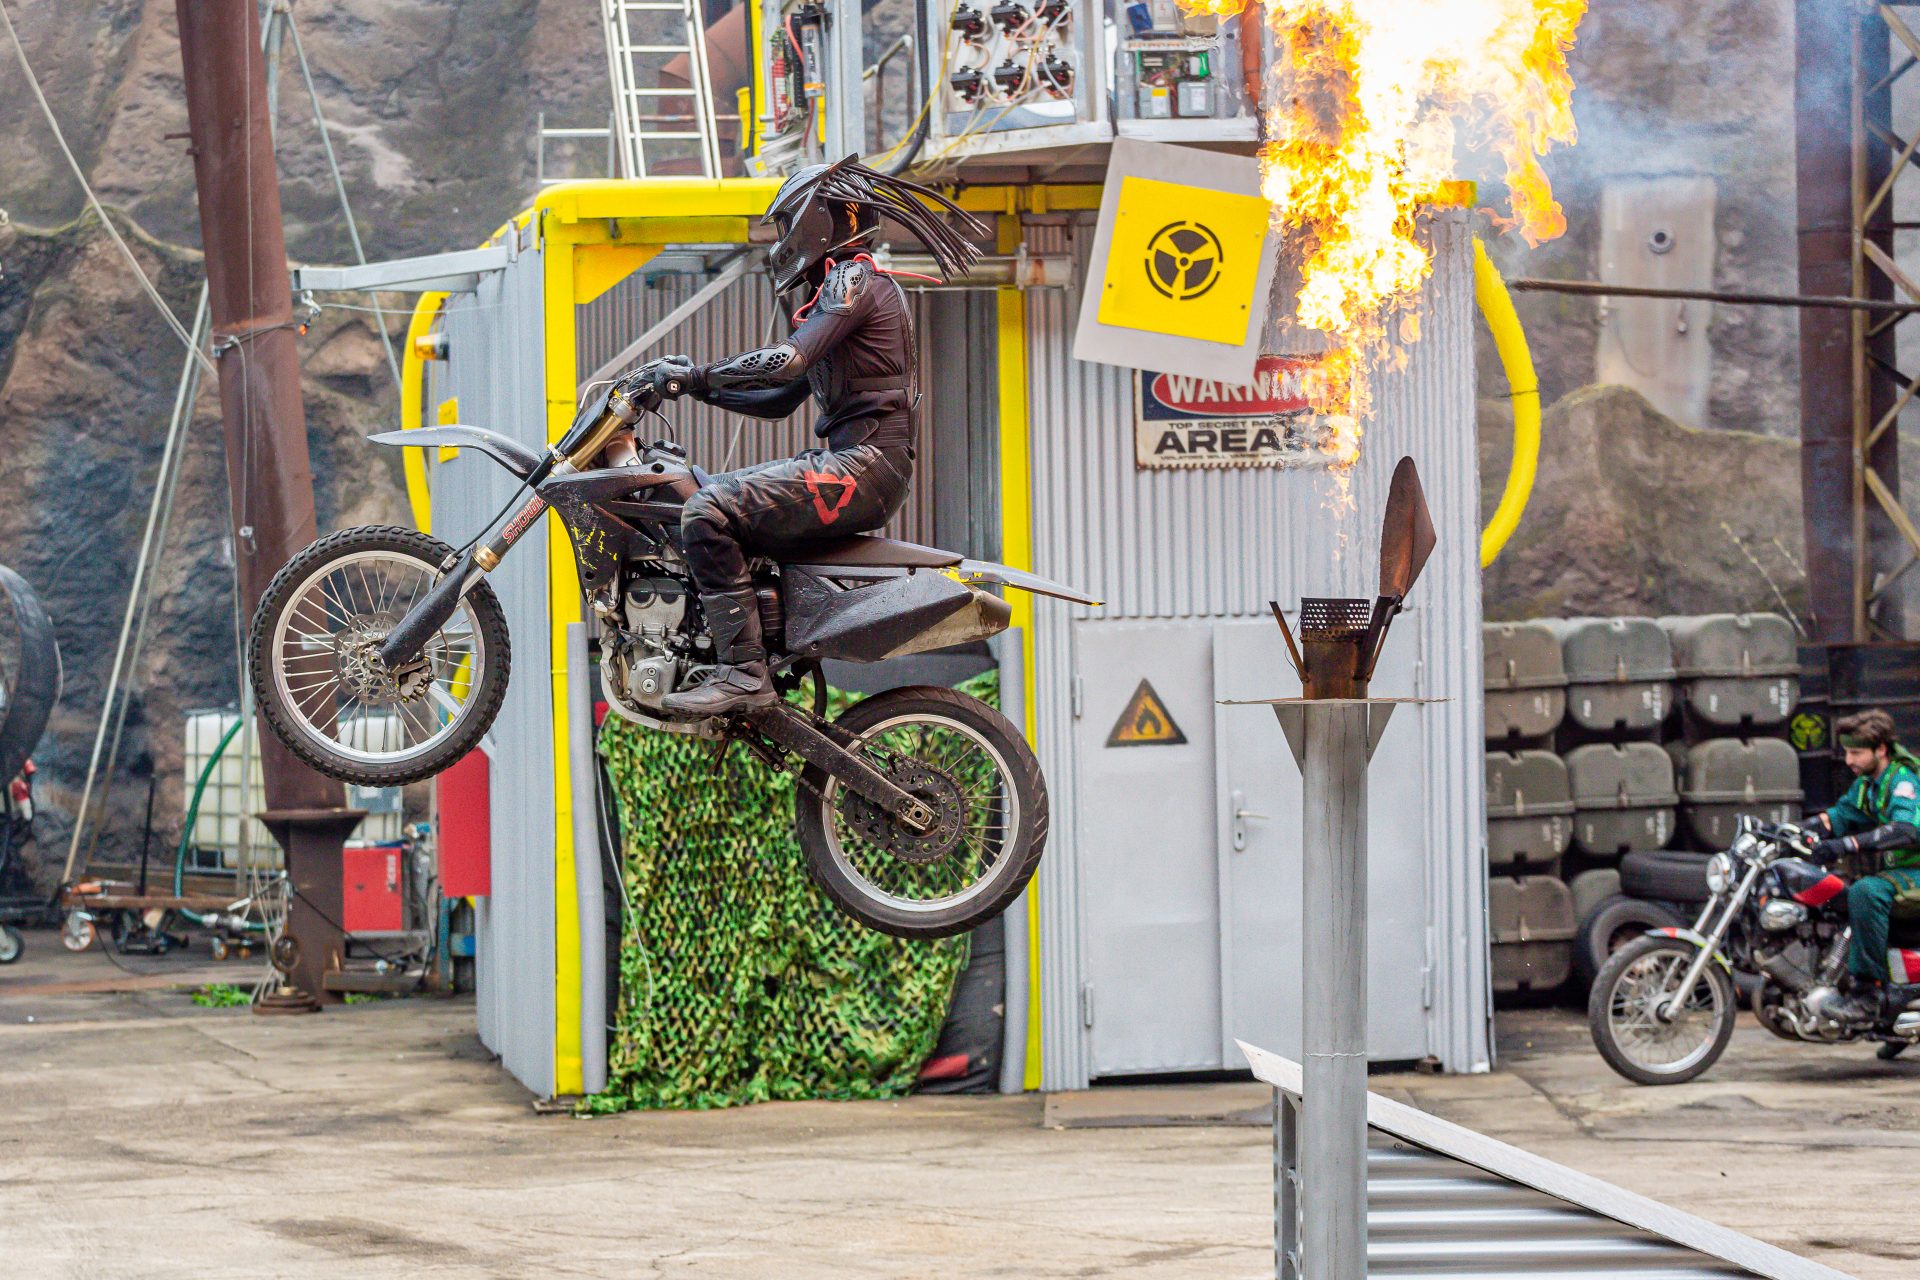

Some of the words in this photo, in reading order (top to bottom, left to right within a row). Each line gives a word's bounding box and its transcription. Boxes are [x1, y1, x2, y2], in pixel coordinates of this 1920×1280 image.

[1168, 422, 1193, 430] TOP
[1197, 421, 1247, 429] SECRET
[1154, 428, 1283, 454] AREA
